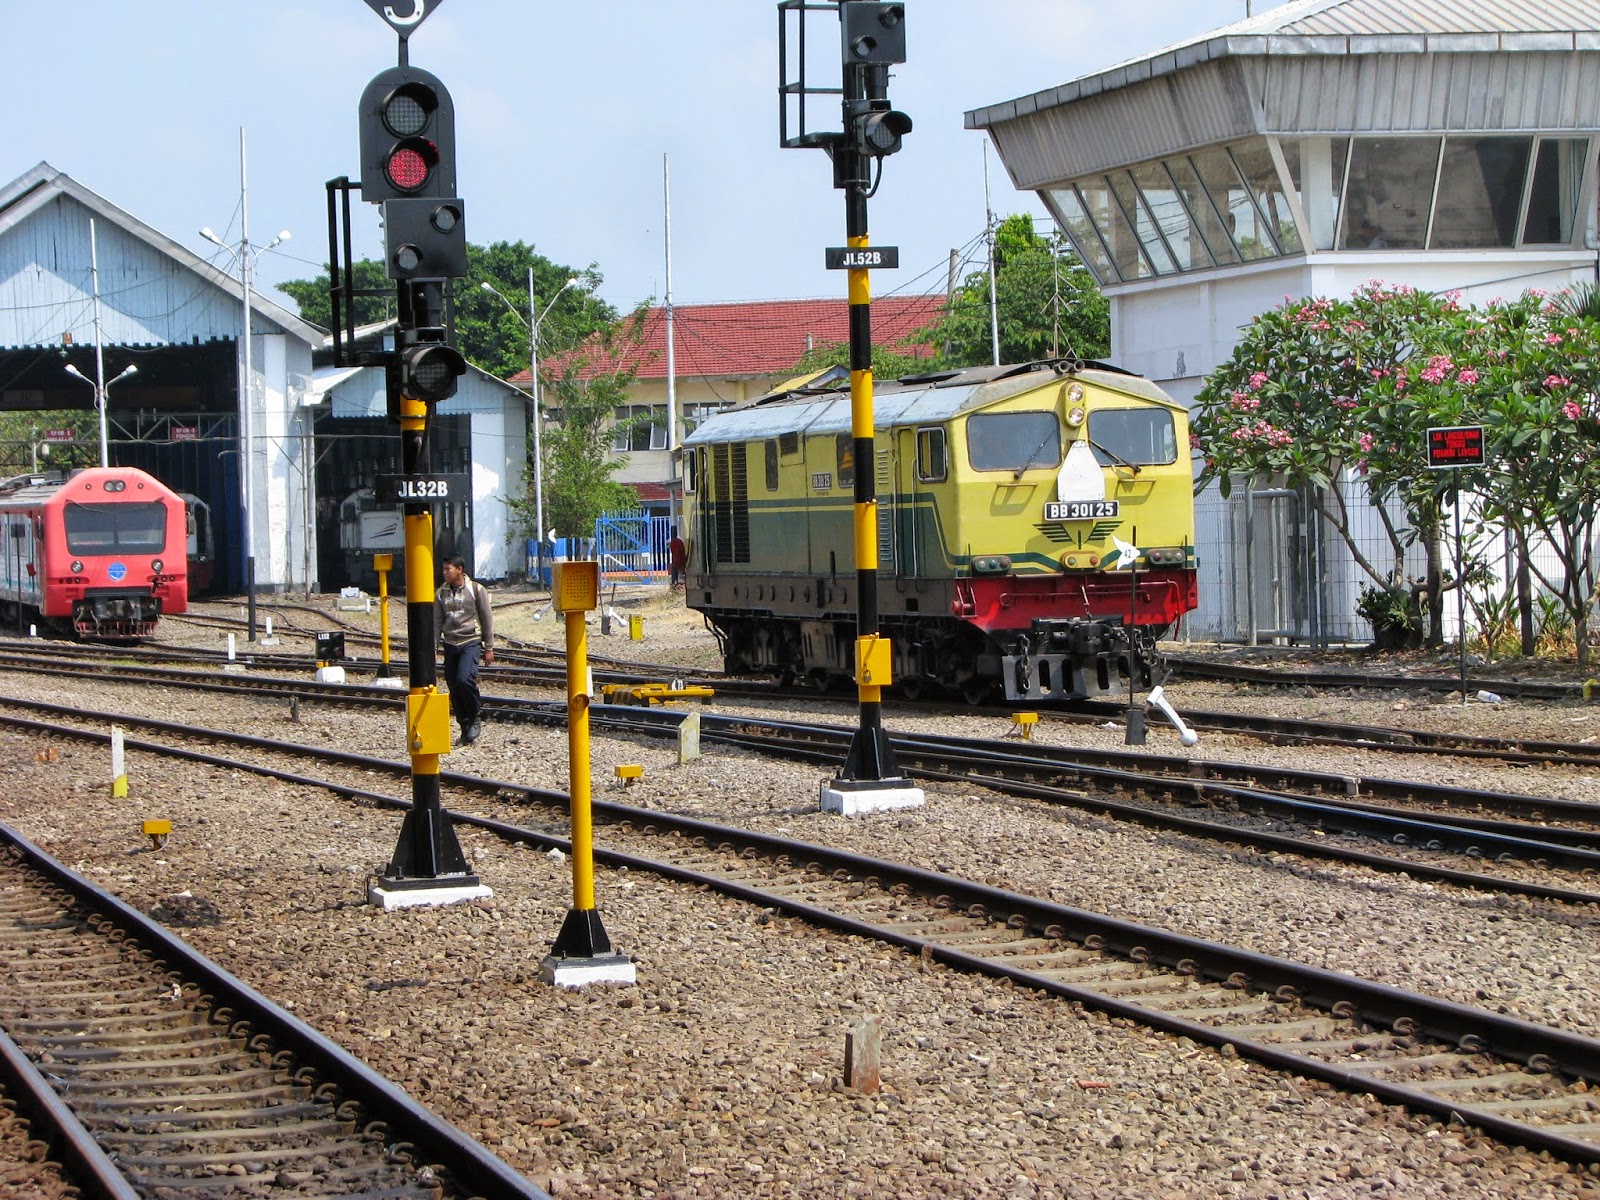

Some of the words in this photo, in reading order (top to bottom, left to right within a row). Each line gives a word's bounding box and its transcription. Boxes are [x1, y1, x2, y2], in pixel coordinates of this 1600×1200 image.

[843, 252, 881, 266] JL52B
[398, 481, 448, 497] JL32B
[1050, 504, 1068, 518] BB
[1124, 549, 1131, 558] 42
